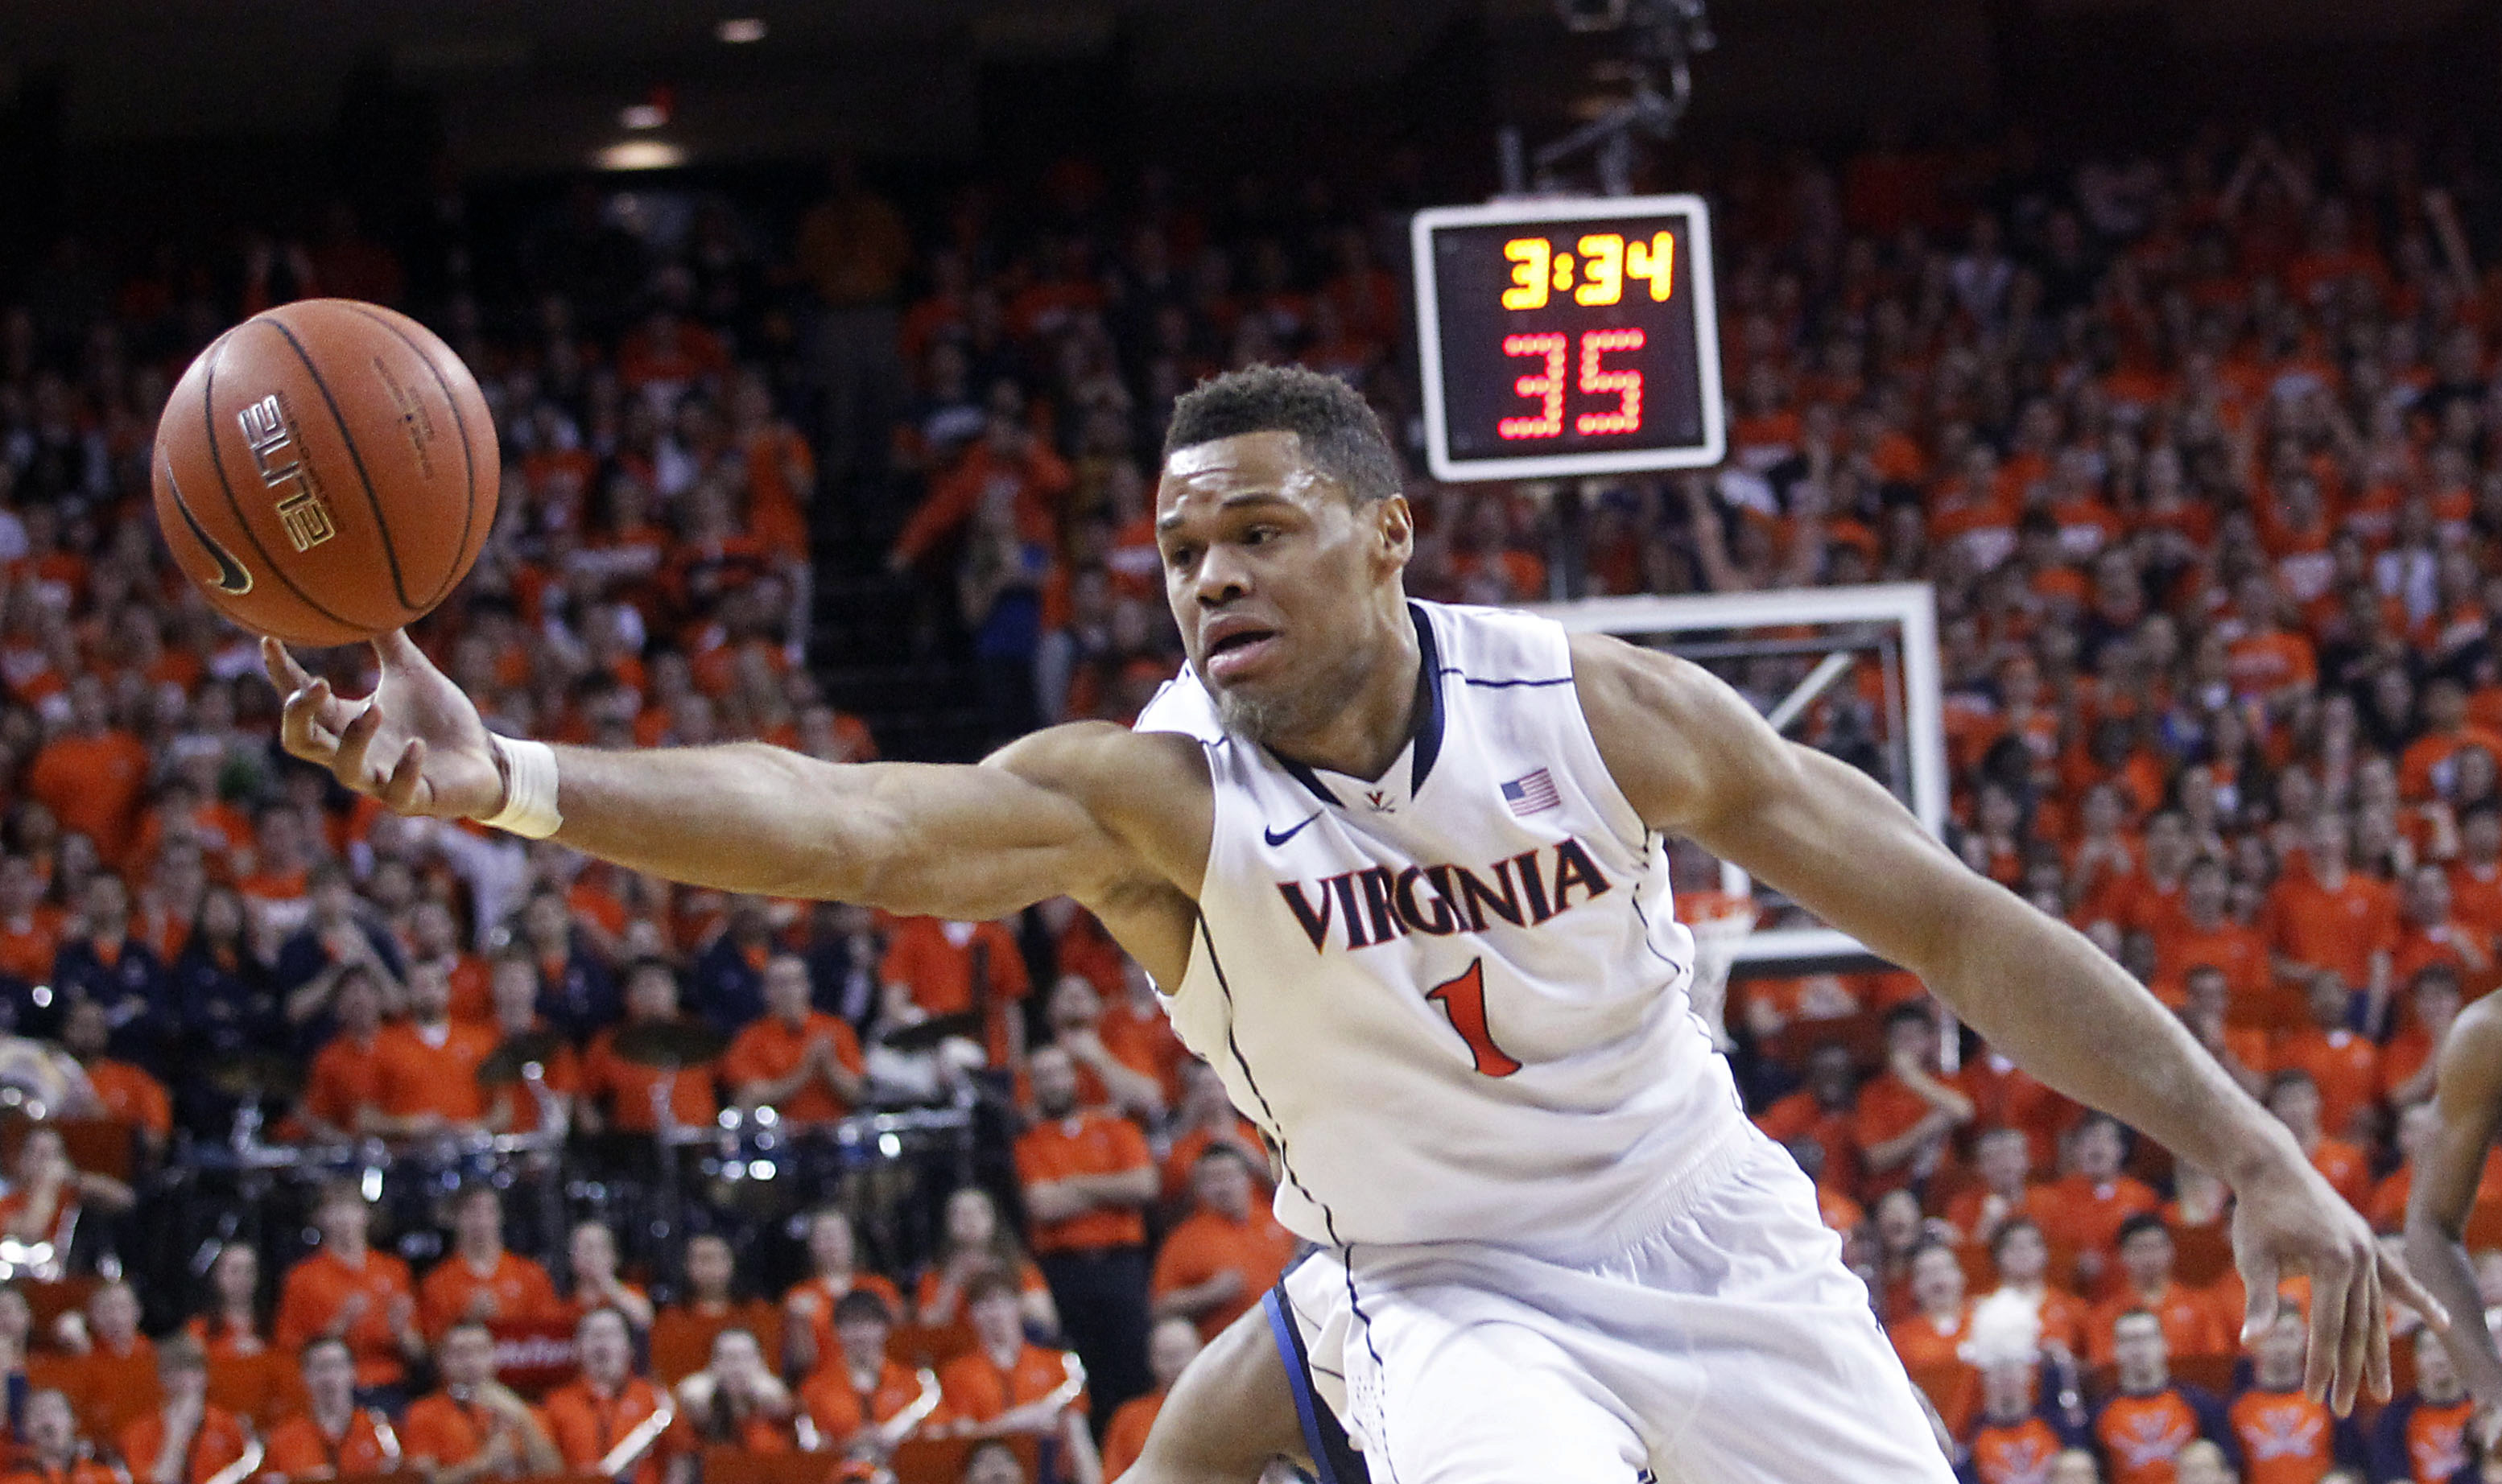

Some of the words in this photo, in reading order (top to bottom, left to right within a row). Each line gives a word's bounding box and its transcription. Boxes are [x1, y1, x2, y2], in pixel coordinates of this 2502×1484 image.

[1501, 230, 1674, 311] 3:34
[1497, 328, 1646, 439] 35
[237, 394, 336, 553] ELITE
[1277, 837, 1612, 955] VIRGINIA
[1426, 955, 1523, 1078] 1
